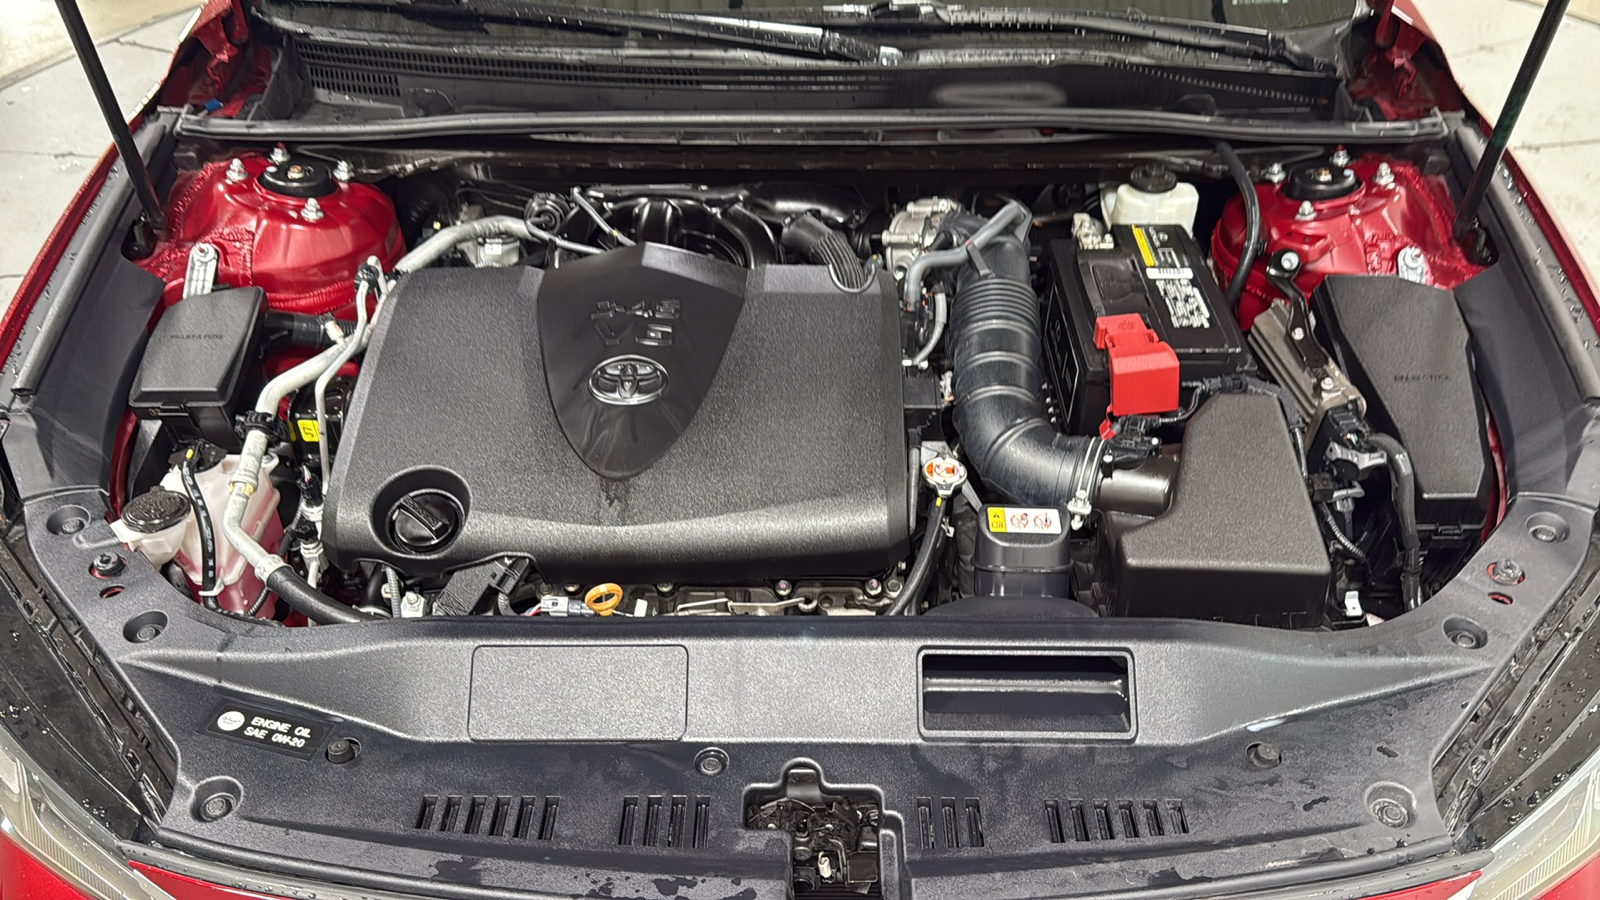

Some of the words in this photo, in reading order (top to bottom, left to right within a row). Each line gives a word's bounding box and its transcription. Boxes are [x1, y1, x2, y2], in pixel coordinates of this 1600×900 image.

[244, 726, 268, 739] SAE
[271, 732, 306, 748] 0W-20
[251, 716, 291, 733] ENGINE
[294, 726, 311, 738] OIL
